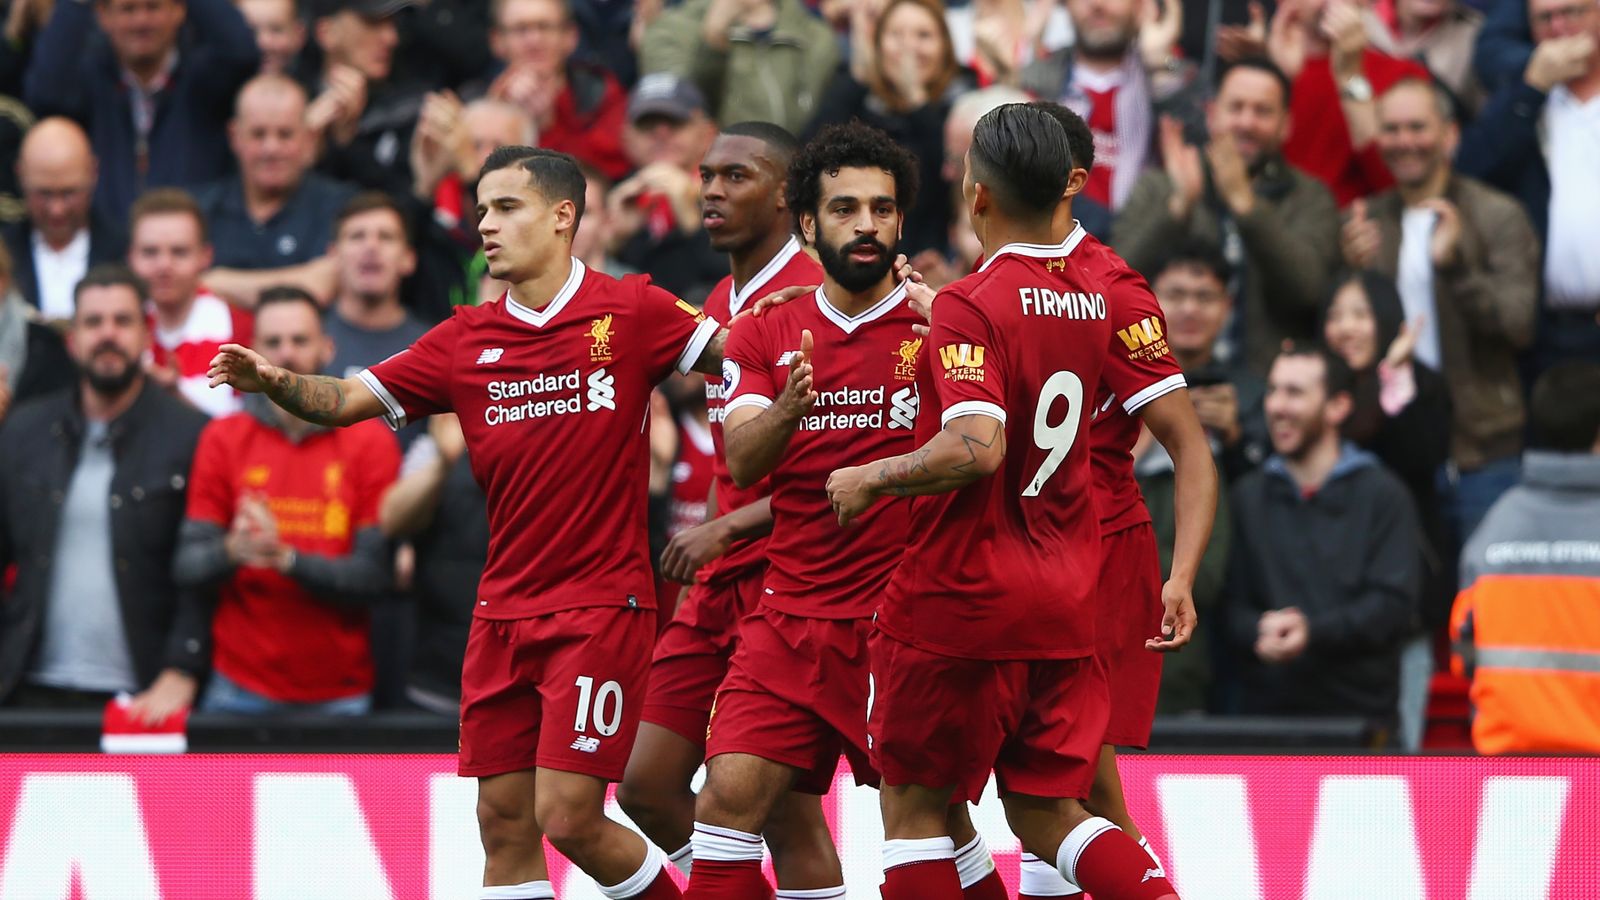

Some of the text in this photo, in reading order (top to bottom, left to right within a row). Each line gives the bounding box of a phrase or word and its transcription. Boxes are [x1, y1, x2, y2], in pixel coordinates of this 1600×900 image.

[1018, 287, 1107, 320] FIRMINO
[590, 346, 612, 356] LFC
[938, 343, 985, 370] WU
[487, 369, 580, 401] Standard
[894, 366, 916, 376] LFC
[485, 393, 581, 426] Chartered
[799, 409, 883, 431] hartered
[1021, 370, 1084, 497] 9
[574, 675, 624, 737] 10
